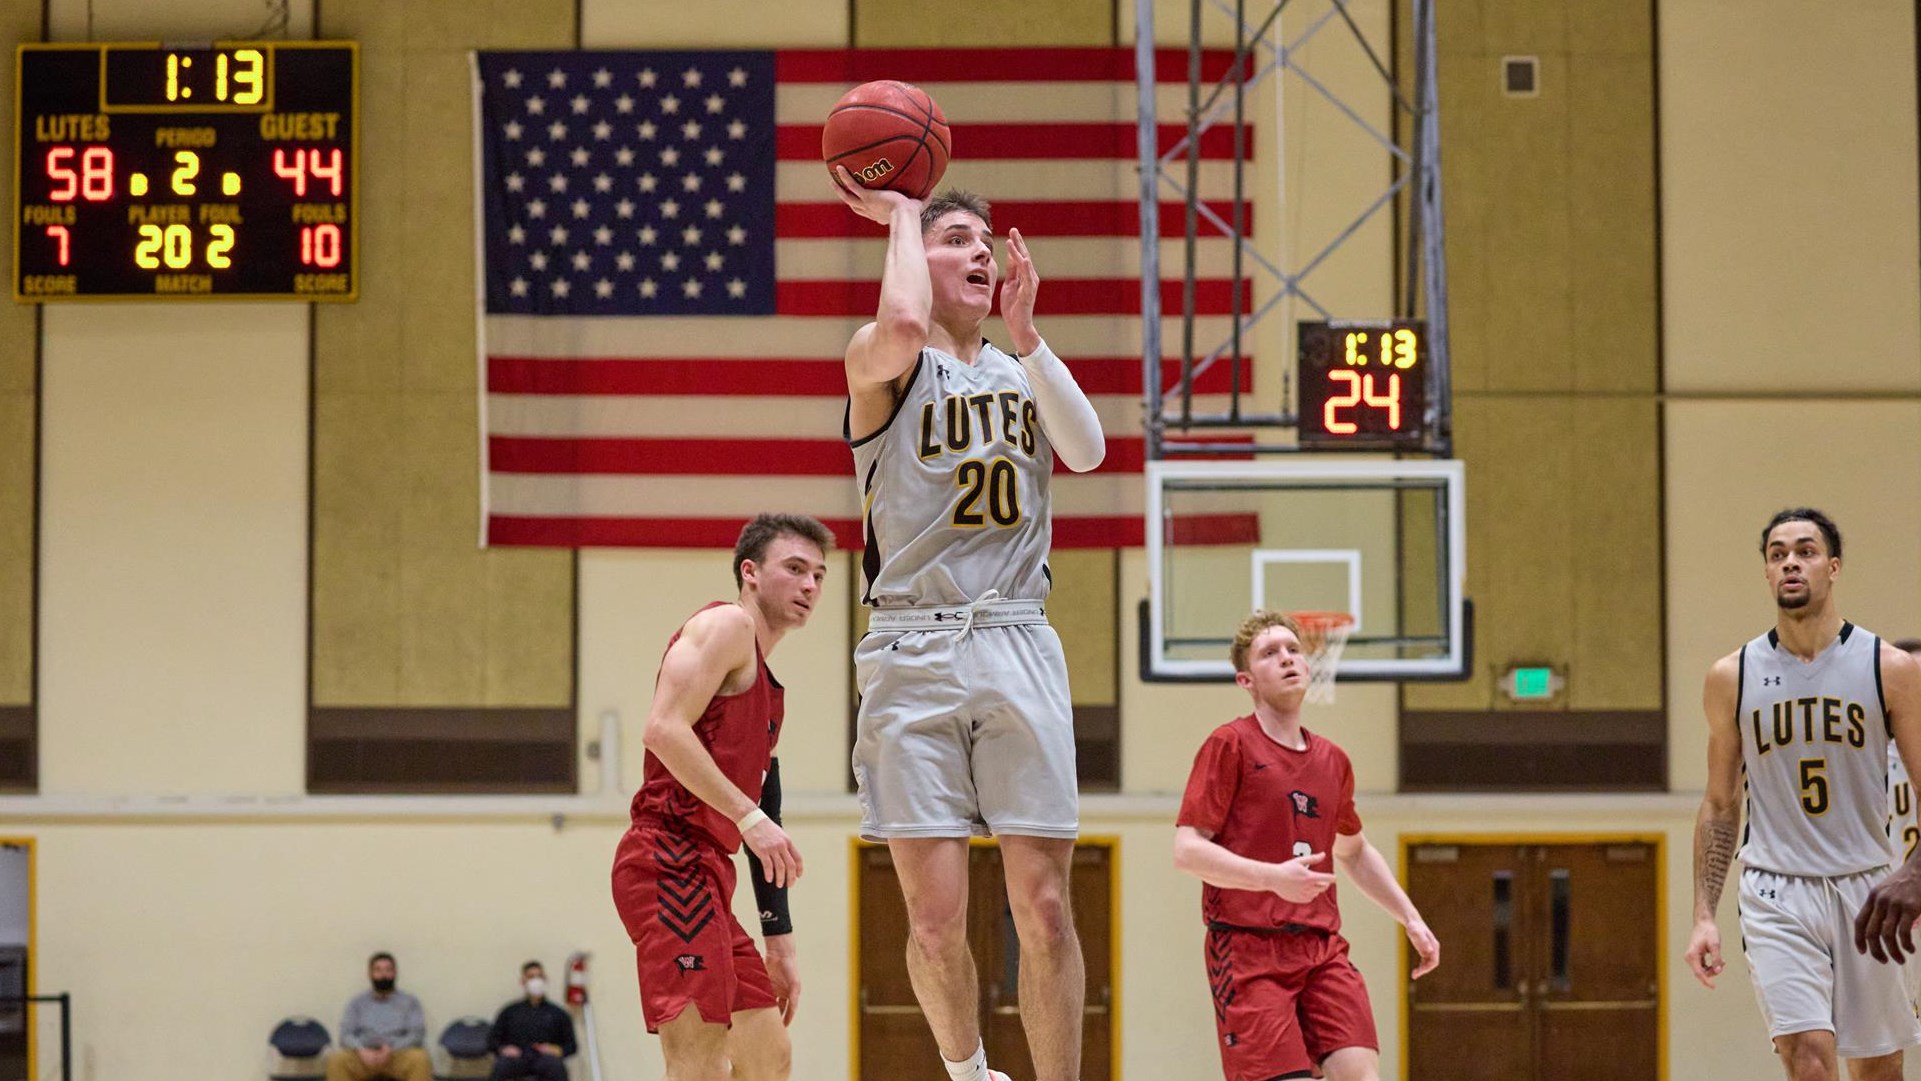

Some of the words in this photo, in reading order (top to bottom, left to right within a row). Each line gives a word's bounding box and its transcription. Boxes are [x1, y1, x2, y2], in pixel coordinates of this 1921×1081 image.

[165, 49, 264, 105] 1:13
[35, 114, 111, 142] LUTES
[259, 112, 340, 141] GUEST
[46, 147, 114, 201] 58
[171, 150, 200, 196] 2
[272, 148, 343, 197] 44
[23, 204, 77, 226] FOULS
[128, 203, 191, 225] PLAYER
[199, 203, 244, 225] FOUL
[292, 202, 348, 225] FOULS
[46, 225, 70, 267] 7
[135, 223, 192, 270] 20
[206, 223, 235, 269] 2
[300, 223, 342, 268] 10
[23, 274, 78, 295] SCORE
[155, 274, 213, 294] MATCH
[293, 273, 348, 294] SCORE
[1345, 328, 1417, 369] 1:13
[1323, 368, 1400, 434] 24
[919, 390, 1037, 462] LUTES
[952, 456, 1022, 528] 20
[1752, 696, 1866, 756] LUTES
[1799, 757, 1831, 818] 5
